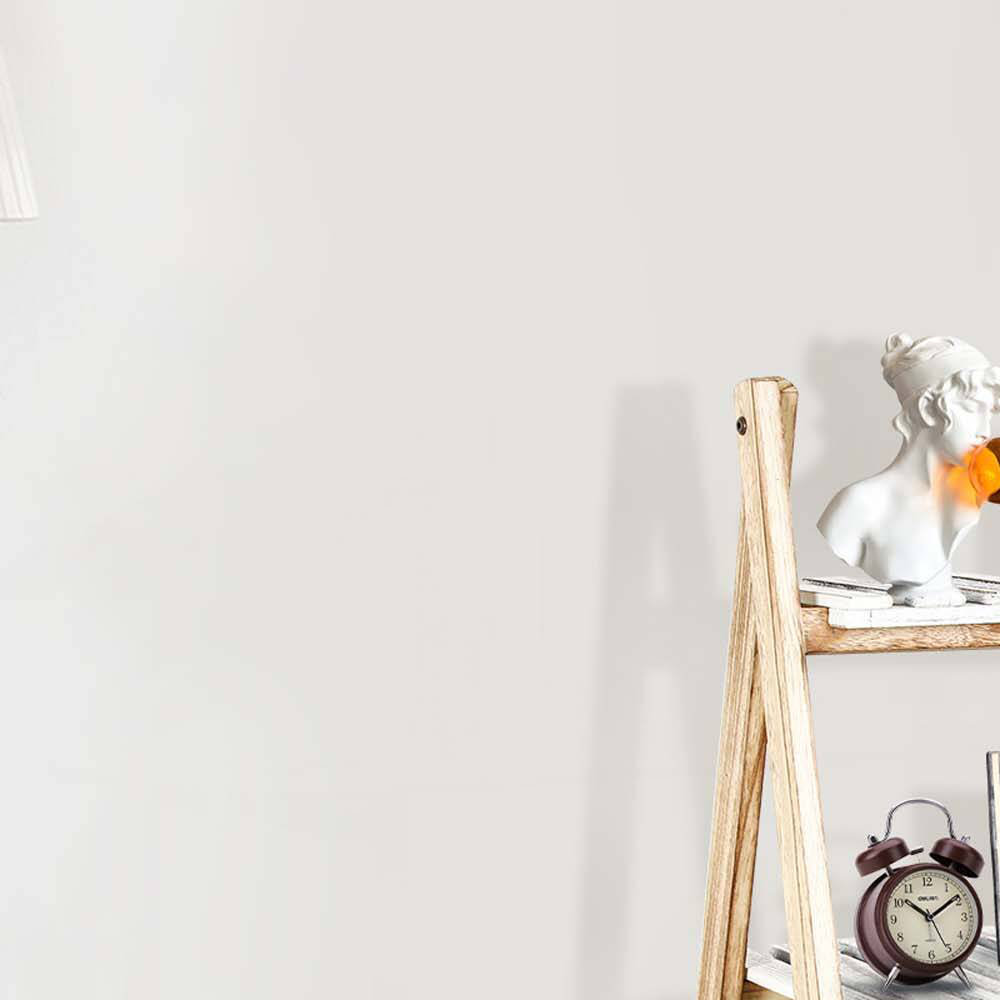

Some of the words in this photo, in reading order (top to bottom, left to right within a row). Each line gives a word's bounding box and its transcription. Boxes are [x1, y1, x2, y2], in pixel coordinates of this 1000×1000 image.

[922, 876, 934, 887] 12
[904, 884, 913, 893] 11
[894, 898, 904, 908] 10
[890, 915, 897, 924] 9
[961, 912, 968, 922] 3
[897, 932, 904, 942] 8
[957, 931, 964, 940] 4
[911, 944, 918, 954] 7
[928, 950, 936, 960] 6
